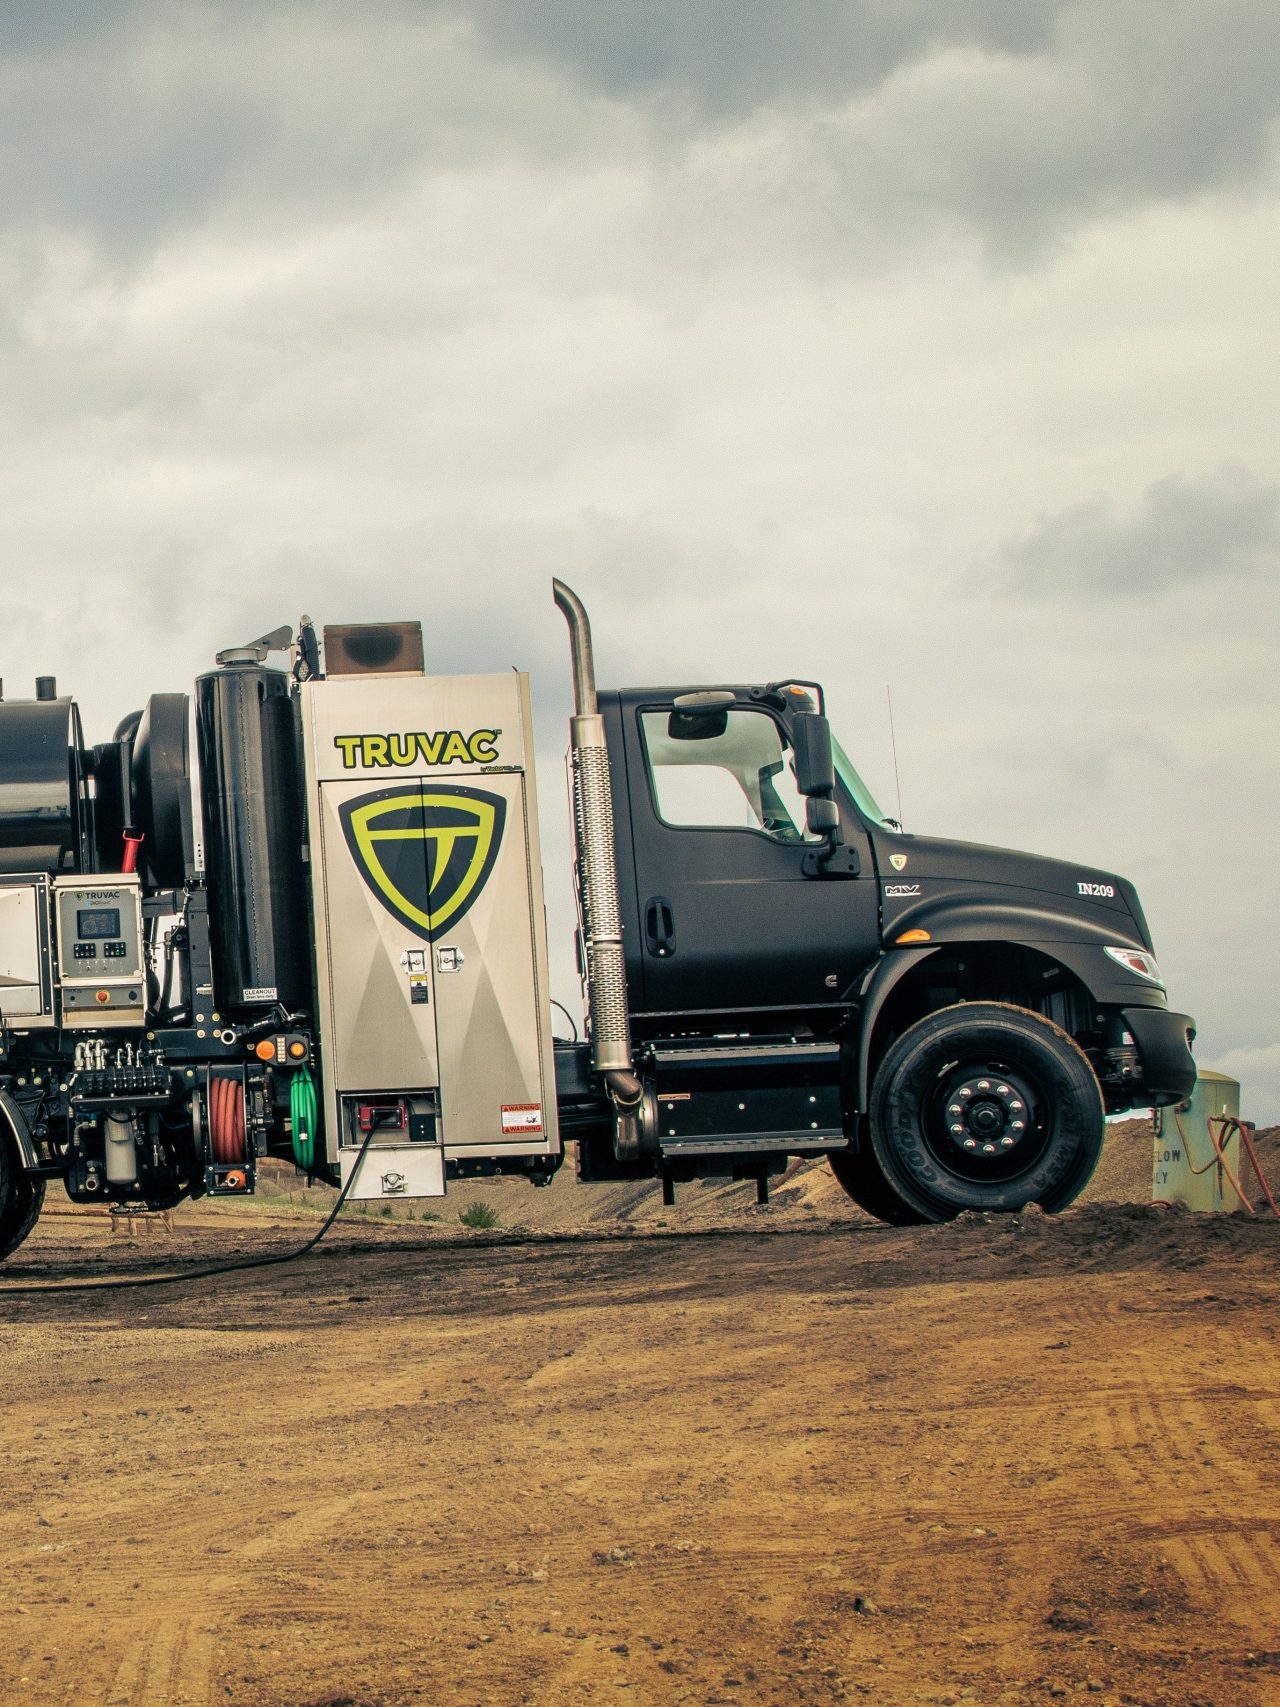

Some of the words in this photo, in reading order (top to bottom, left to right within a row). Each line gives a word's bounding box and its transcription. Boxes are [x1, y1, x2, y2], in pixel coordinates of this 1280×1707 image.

[334, 729, 499, 768] TRUVAC
[85, 891, 120, 899] TRUVAC
[1077, 882, 1114, 897] IN209
